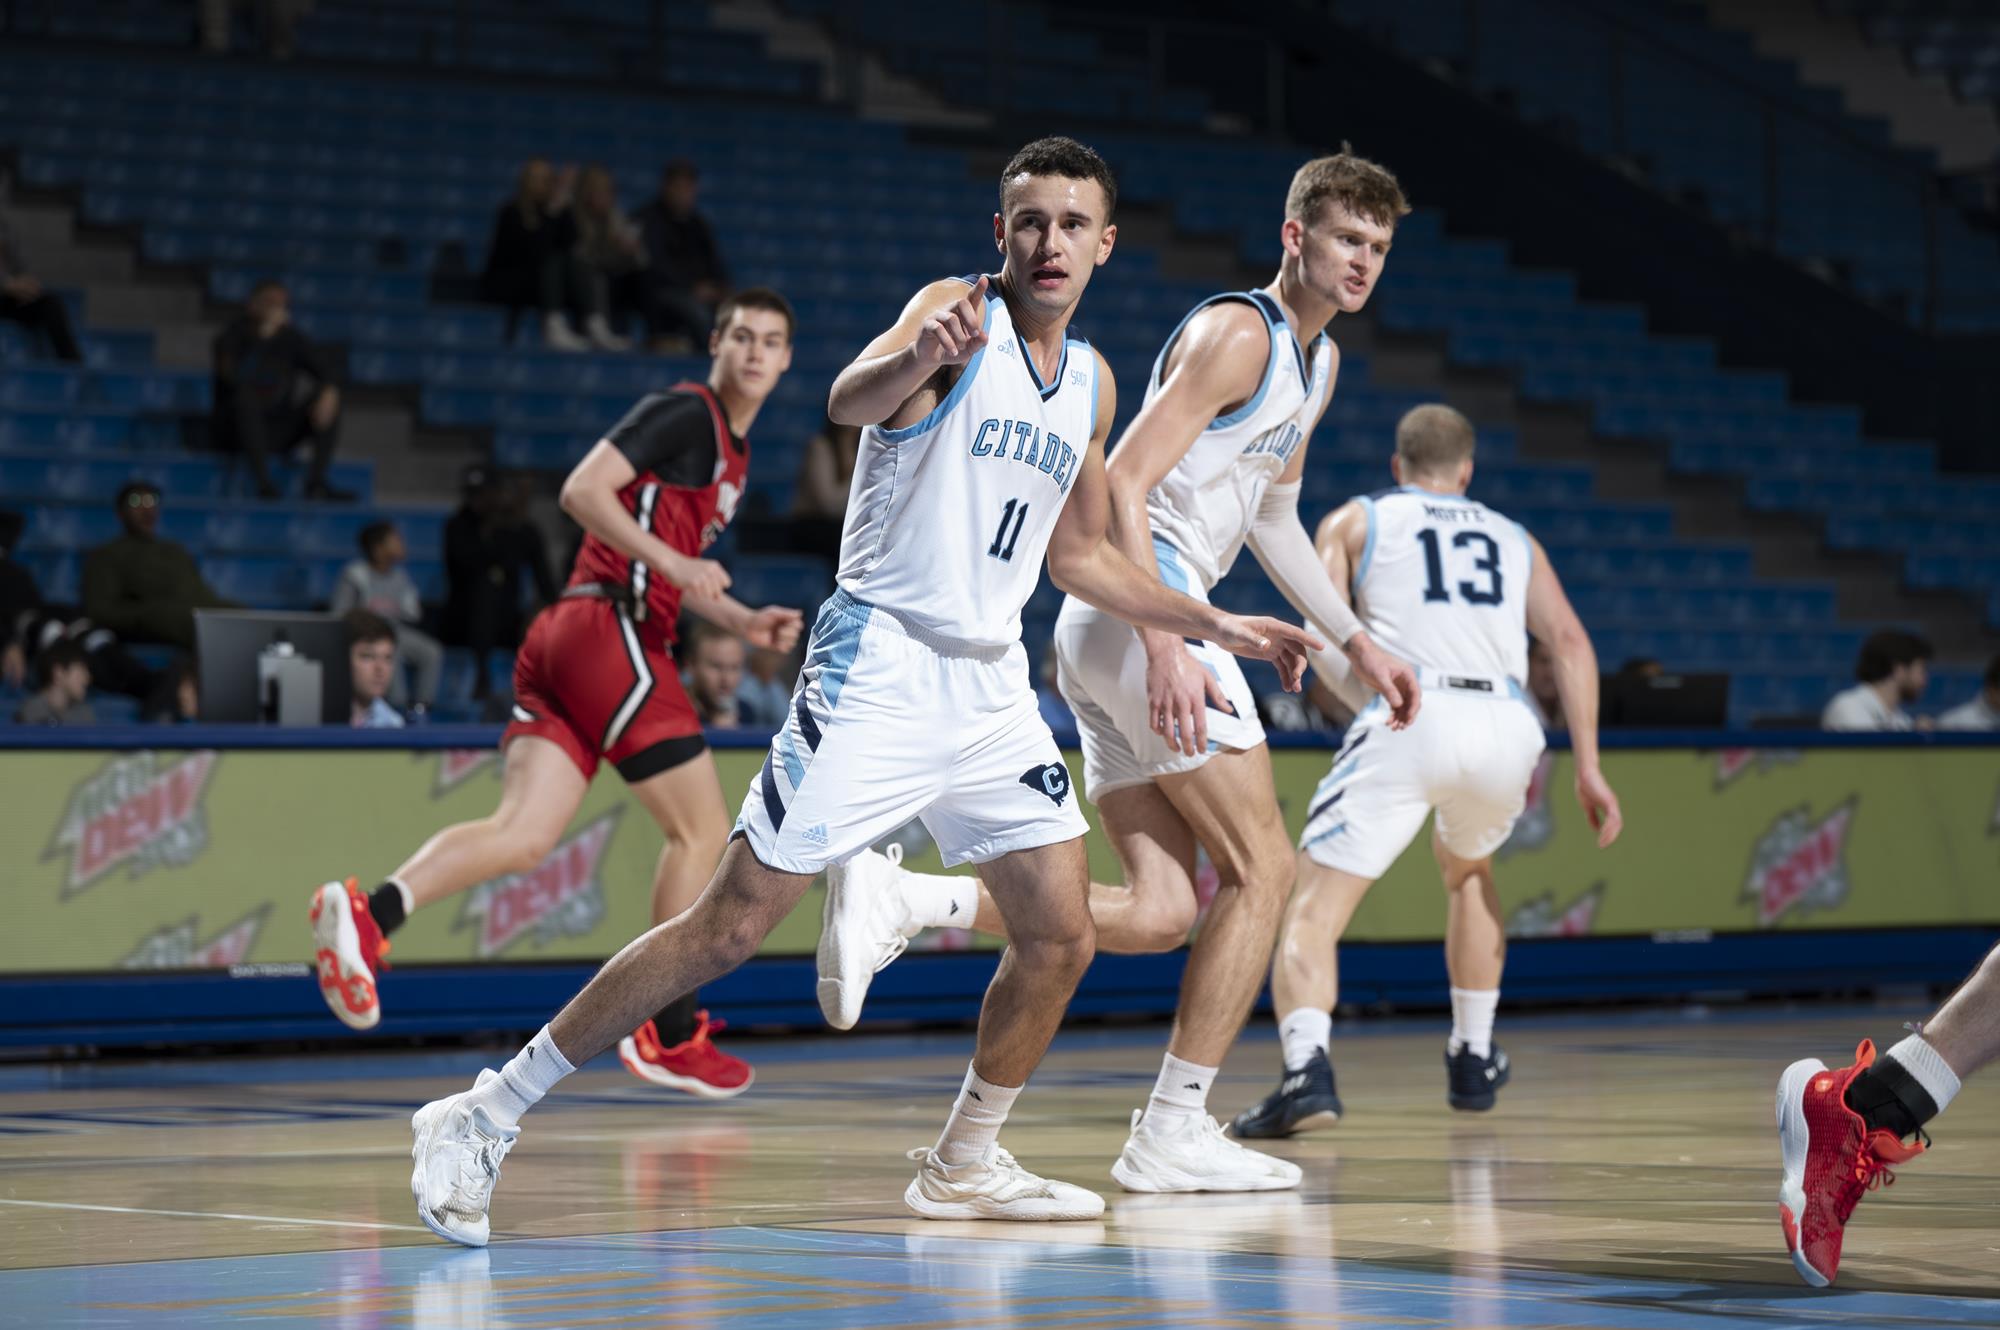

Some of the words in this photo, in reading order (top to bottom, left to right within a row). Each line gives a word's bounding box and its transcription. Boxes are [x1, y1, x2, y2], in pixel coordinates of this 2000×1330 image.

[970, 418, 1077, 495] CITADEL
[987, 498, 1029, 562] 11
[1416, 528, 1504, 606] 13
[1042, 766, 1064, 795] C
